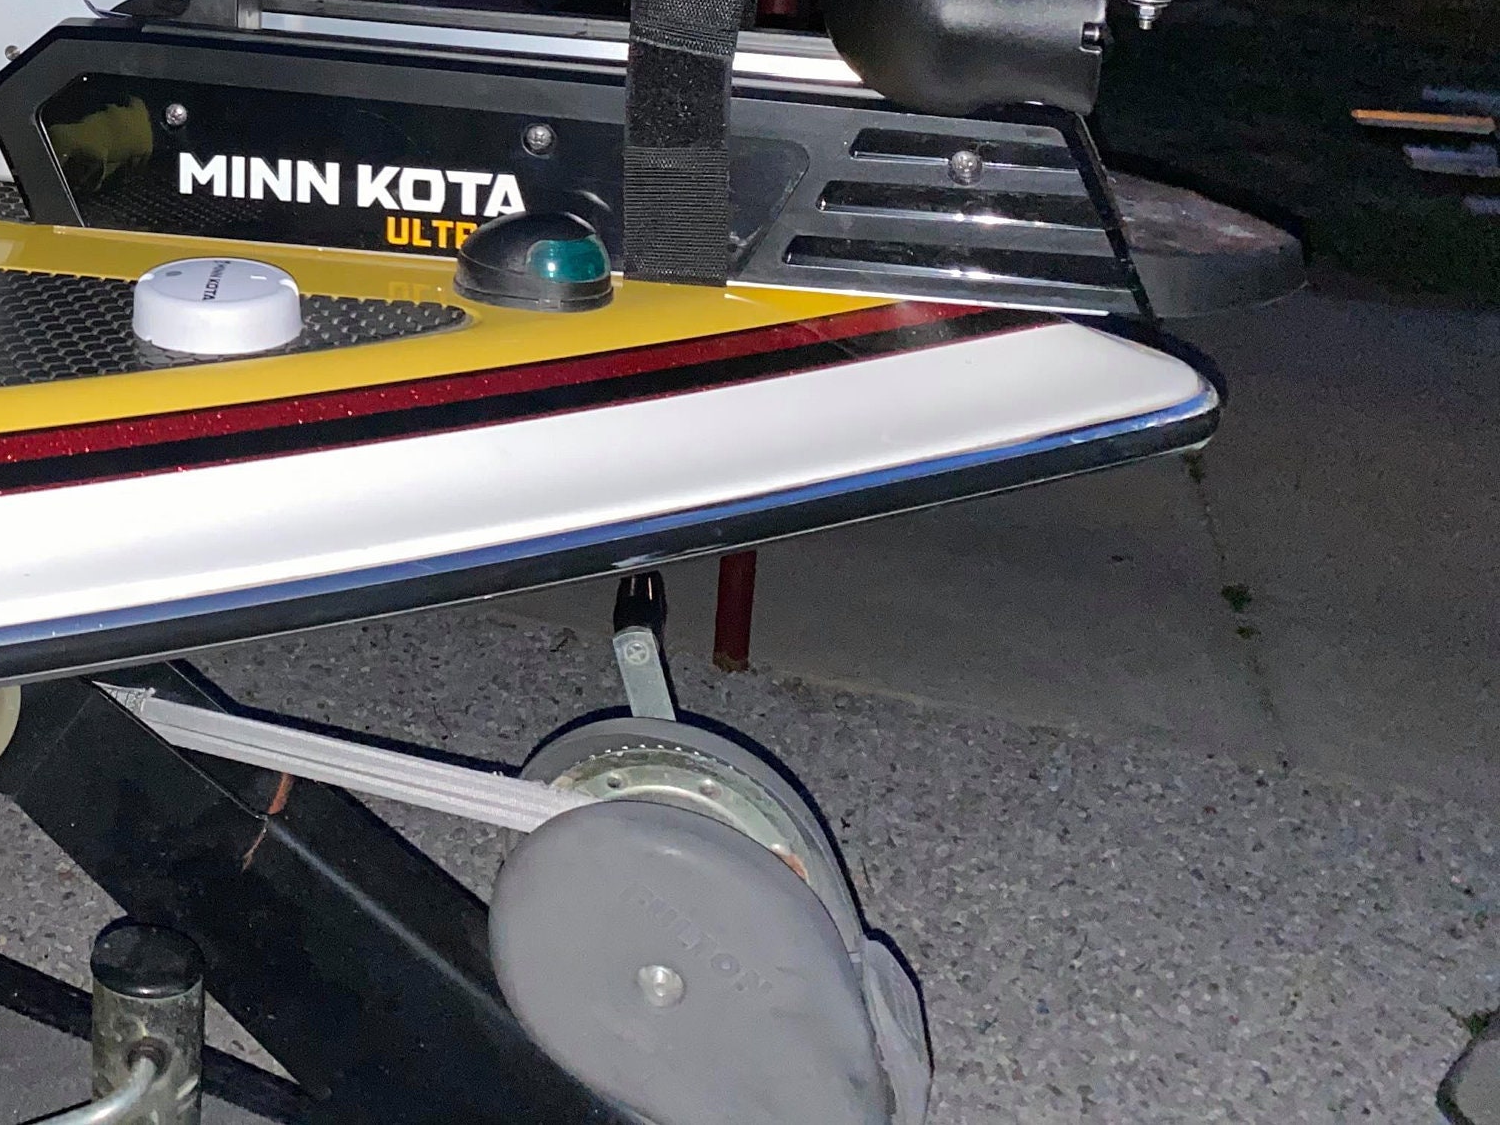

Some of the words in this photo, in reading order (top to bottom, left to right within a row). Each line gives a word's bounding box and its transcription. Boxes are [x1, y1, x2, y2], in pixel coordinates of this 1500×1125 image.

[179, 152, 340, 206] MINN
[357, 163, 526, 217] KOTA
[202, 278, 220, 301] KOTA
